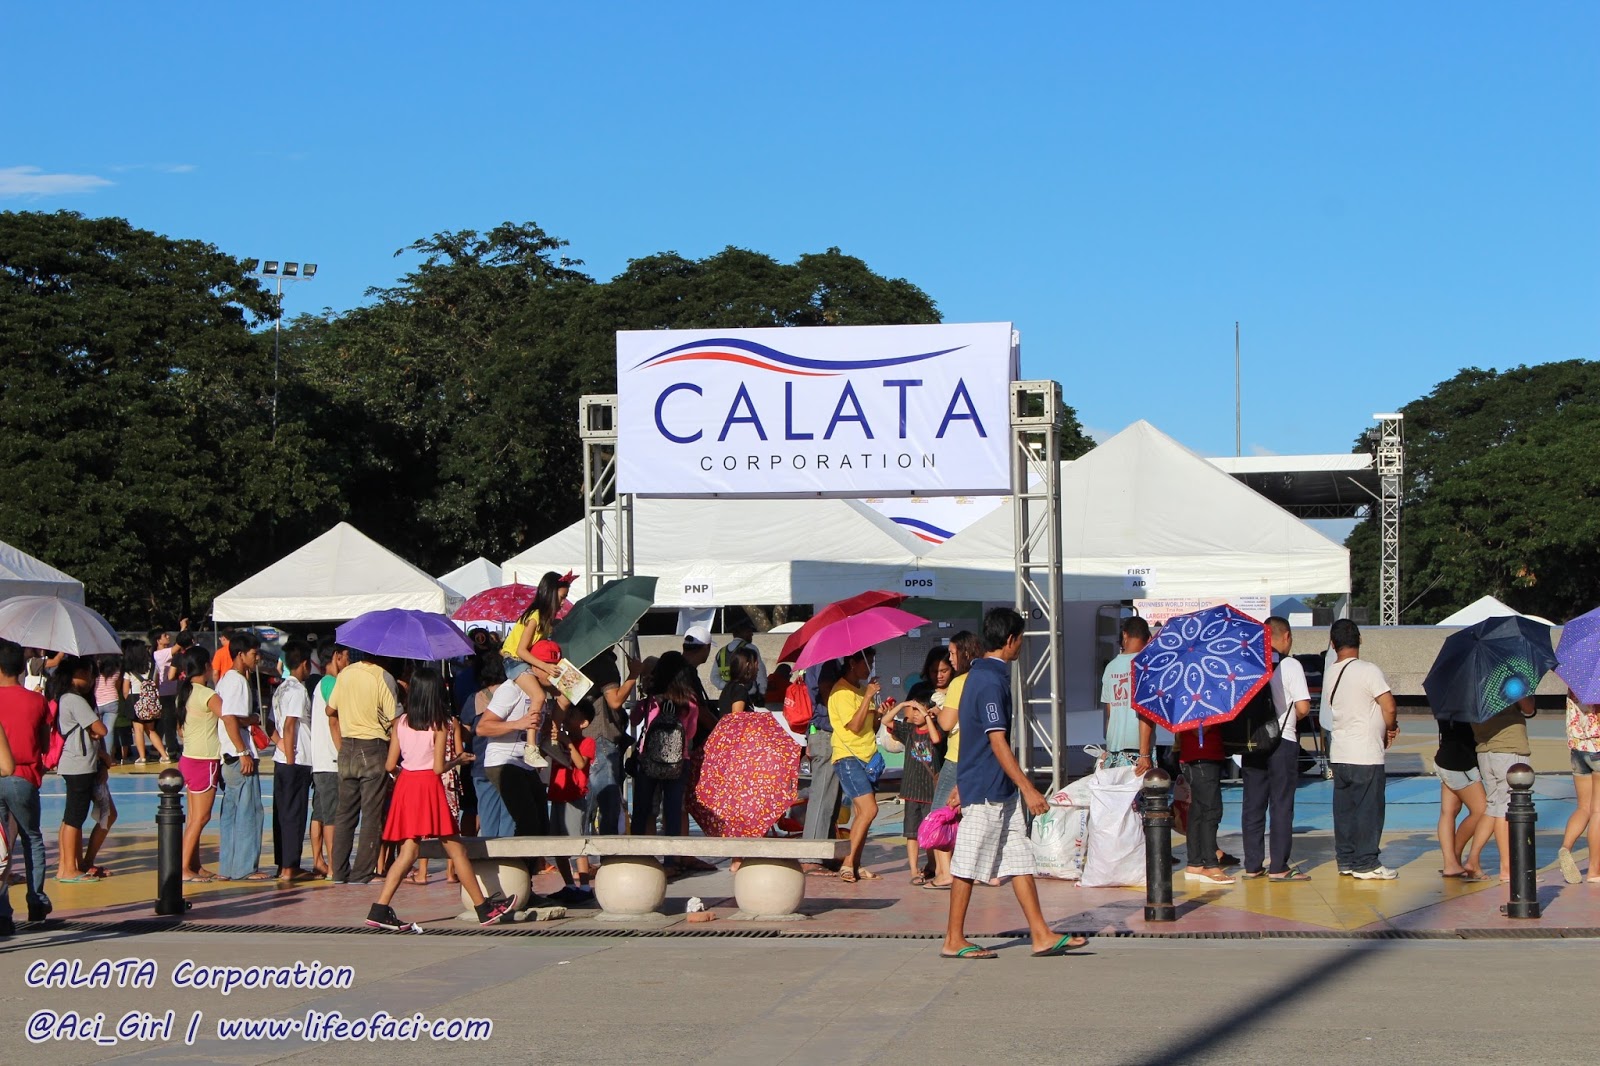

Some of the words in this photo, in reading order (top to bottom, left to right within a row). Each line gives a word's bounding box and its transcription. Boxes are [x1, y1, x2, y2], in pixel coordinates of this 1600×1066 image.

[654, 376, 988, 445] CALATA
[700, 452, 936, 472] CORPORATION
[684, 584, 709, 594] PNP
[904, 579, 933, 588] DPOS
[1236, 680, 1254, 700] AVON
[985, 702, 1000, 723] 8
[1187, 710, 1213, 720] AVON
